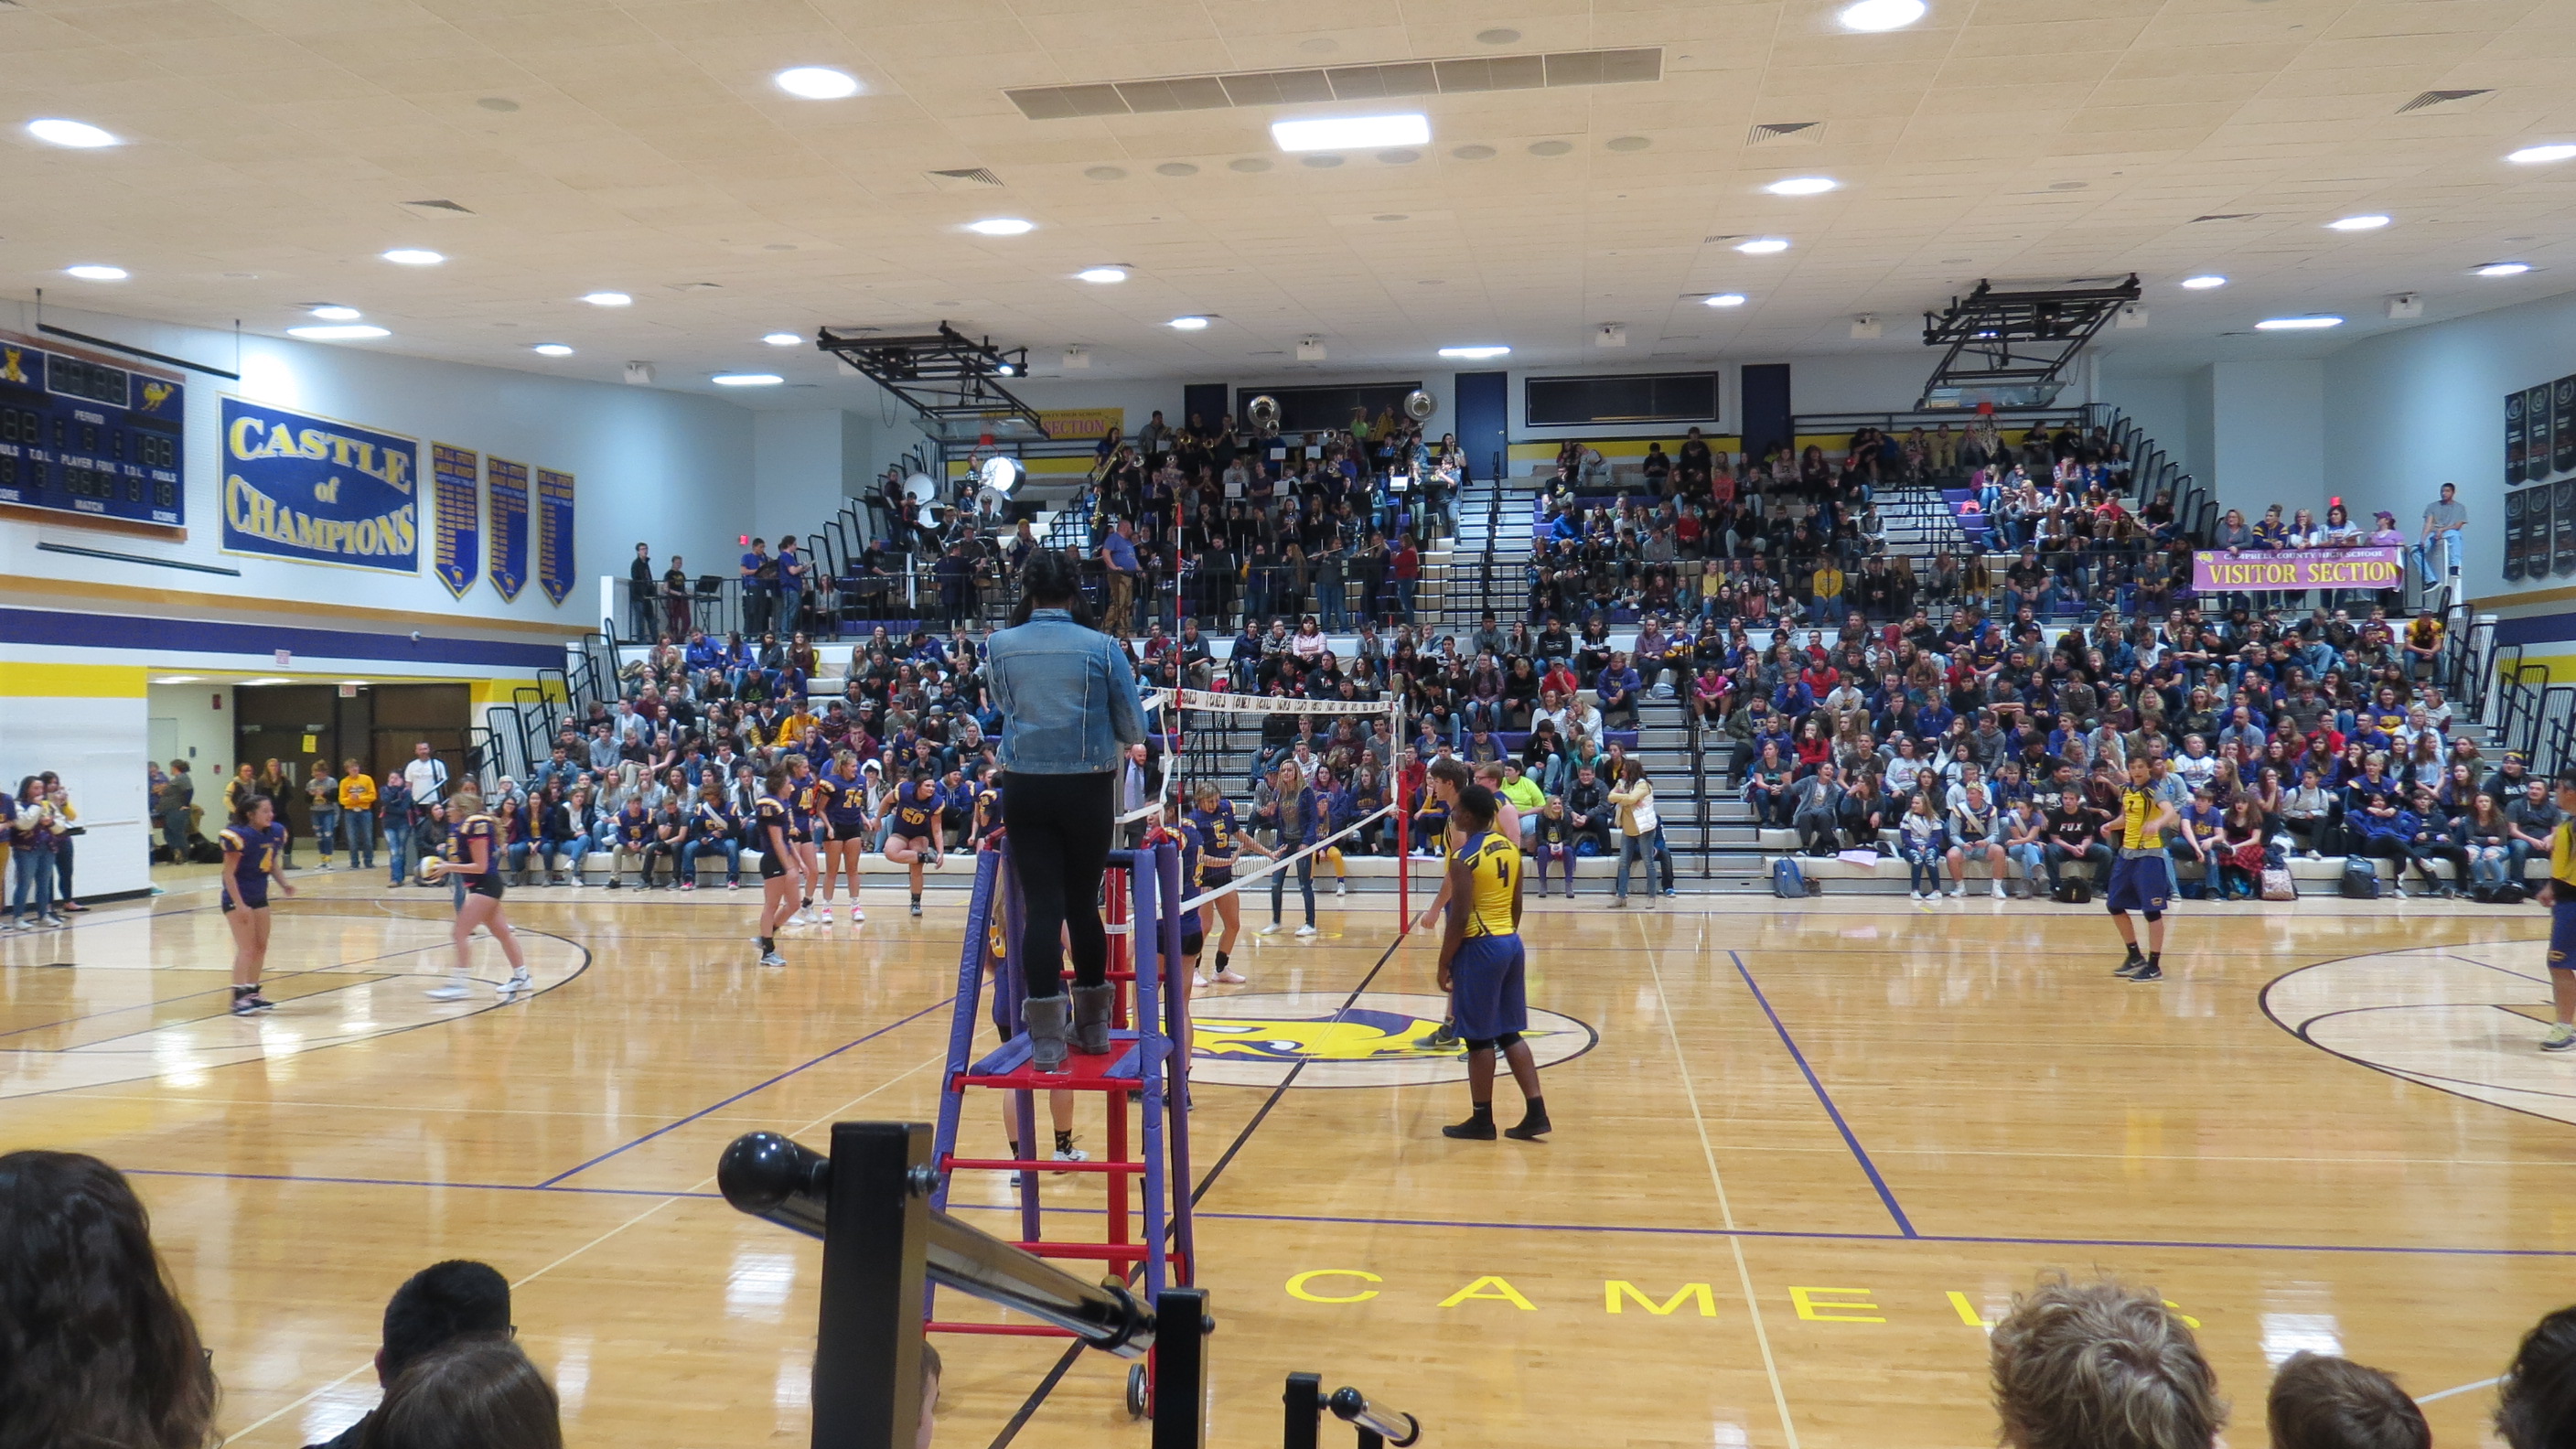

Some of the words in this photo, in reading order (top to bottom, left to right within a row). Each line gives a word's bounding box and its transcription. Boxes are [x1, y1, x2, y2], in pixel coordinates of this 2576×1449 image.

[74, 410, 104, 424] PERIOD
[1044, 420, 1105, 435] SECTION
[61, 454, 92, 469] PLAYER
[230, 416, 411, 495] CASTLE
[314, 476, 340, 504] of
[226, 474, 415, 555] CHAMPIONS
[2345, 550, 2385, 558] SCHOOL
[2208, 564, 2297, 584] VISITOR
[2307, 561, 2396, 583] SECTION
[1214, 823, 1229, 849] 5
[1496, 856, 1509, 887] 4
[1284, 1269, 2201, 1329] CAMEL
